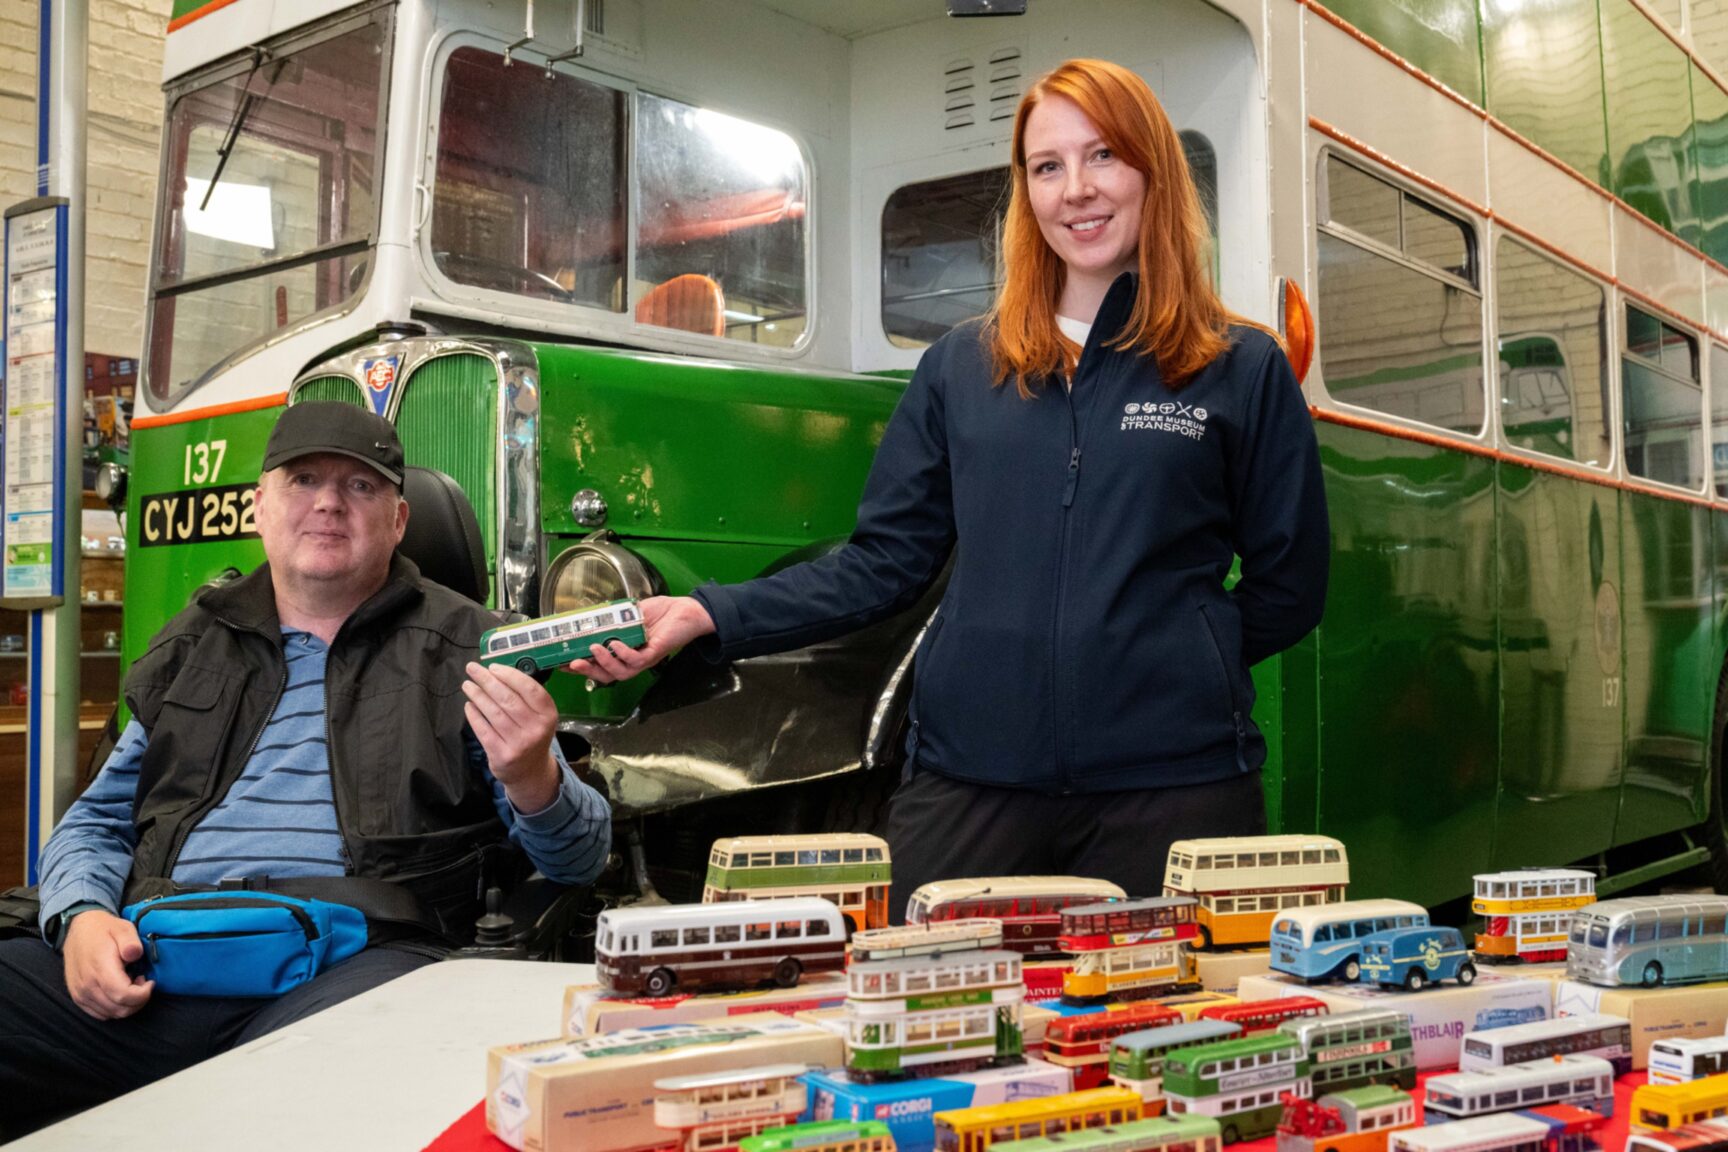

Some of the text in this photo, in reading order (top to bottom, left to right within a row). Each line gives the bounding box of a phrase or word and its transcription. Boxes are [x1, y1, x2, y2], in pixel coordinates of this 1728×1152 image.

[1127, 421, 1205, 441] TRANSPORT
[1166, 416, 1205, 432] MUSEUM
[184, 439, 227, 485] 137
[144, 488, 257, 542] CYJ 252
[1602, 677, 1620, 707] 137
[1027, 987, 1062, 997] AINTE
[1411, 1020, 1464, 1041] THBLAIR
[891, 1097, 932, 1117] CORGI
